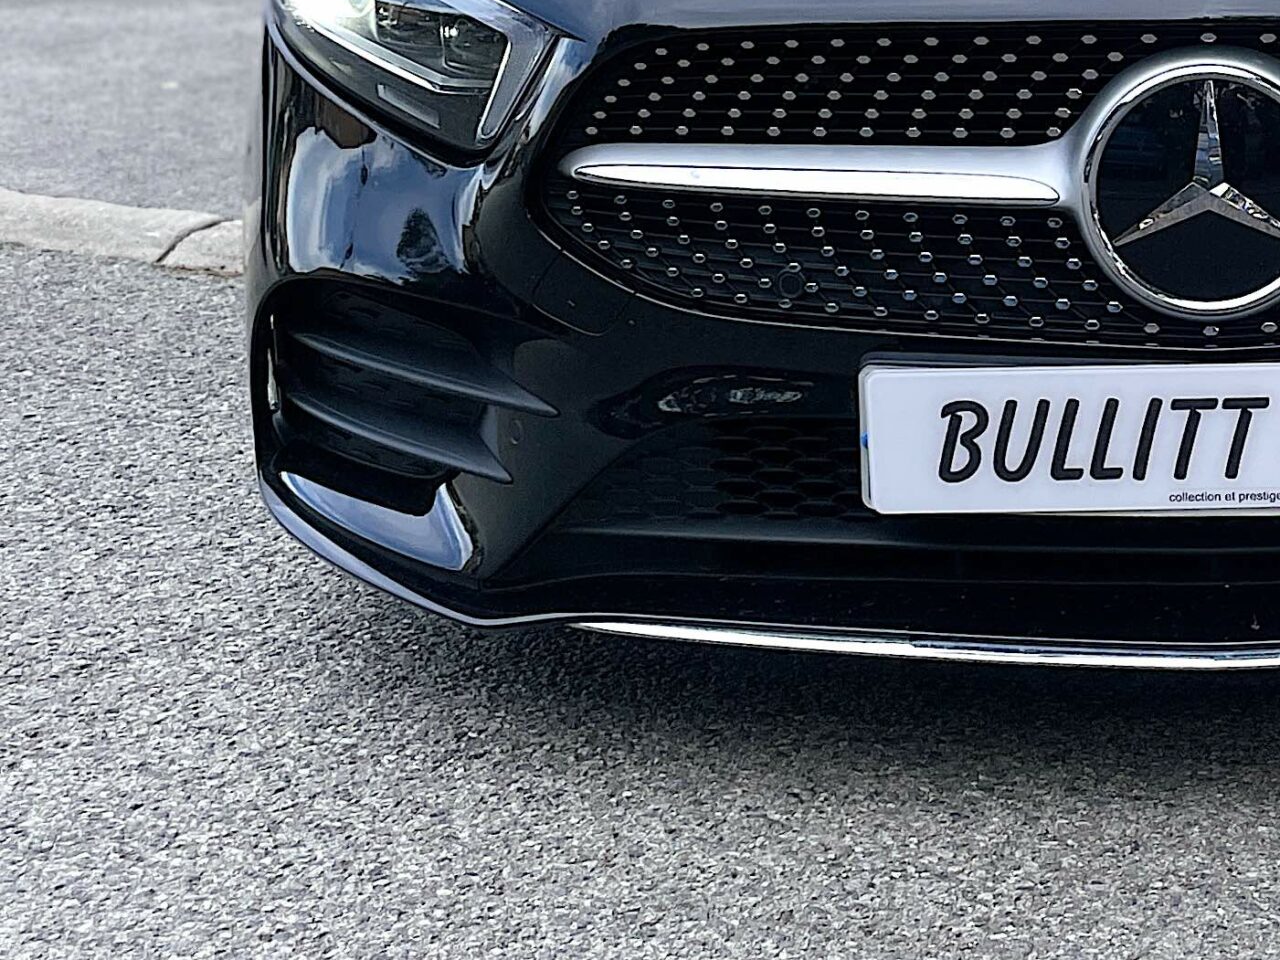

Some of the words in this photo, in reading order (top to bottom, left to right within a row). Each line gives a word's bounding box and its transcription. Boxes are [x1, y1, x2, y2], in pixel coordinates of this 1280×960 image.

[938, 397, 1270, 483] BULLITT
[1169, 491, 1221, 502] collection
[1225, 491, 1235, 501] et
